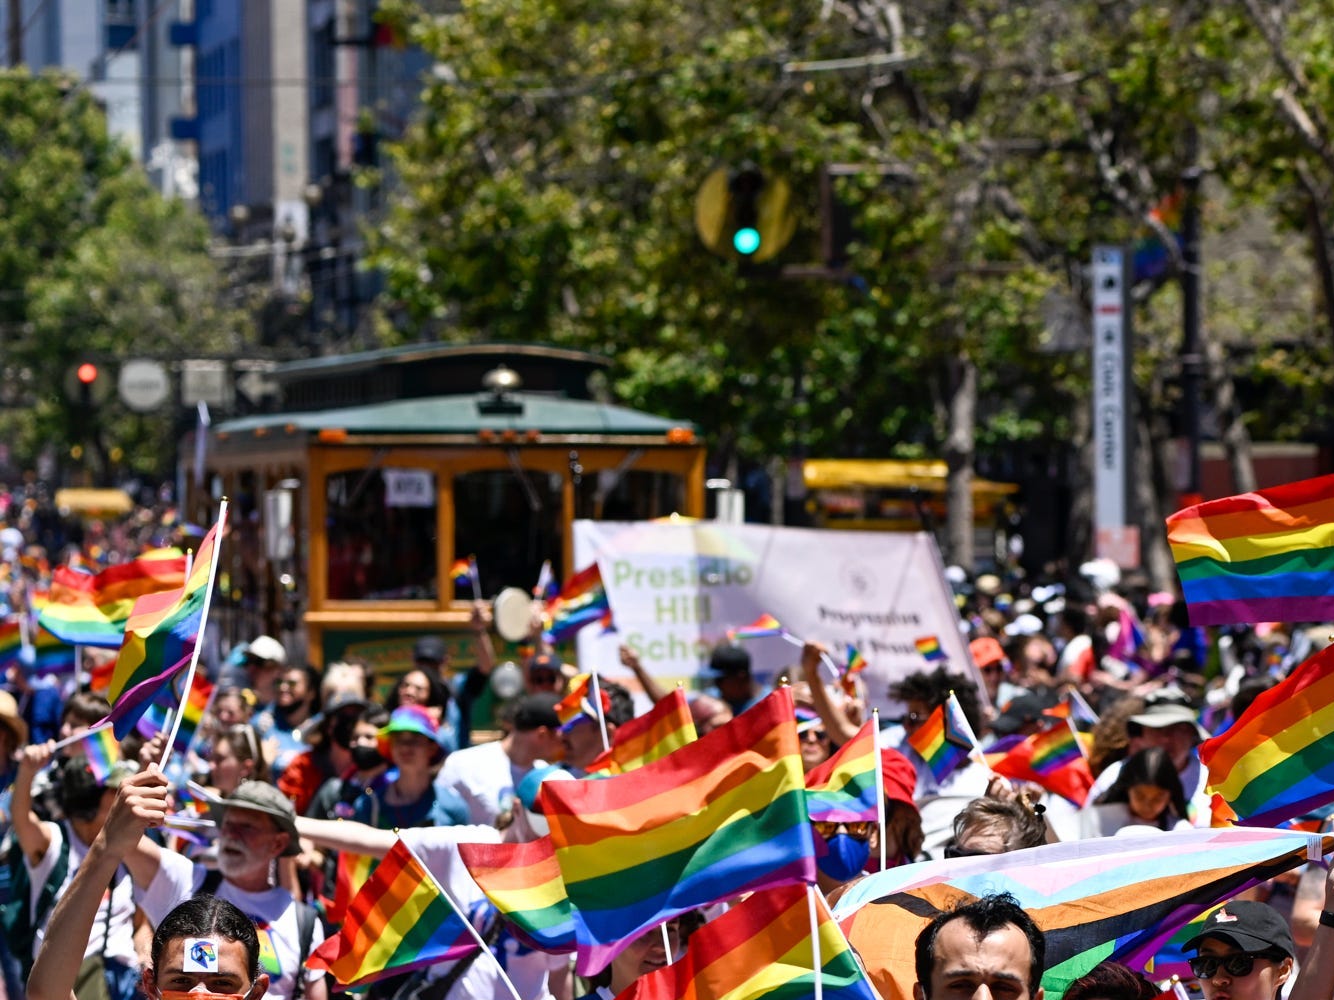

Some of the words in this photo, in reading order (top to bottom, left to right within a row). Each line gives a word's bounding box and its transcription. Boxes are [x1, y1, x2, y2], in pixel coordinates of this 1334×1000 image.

[613, 559, 754, 588] Presidio
[655, 596, 711, 624] Hill
[626, 631, 711, 662] Scho
